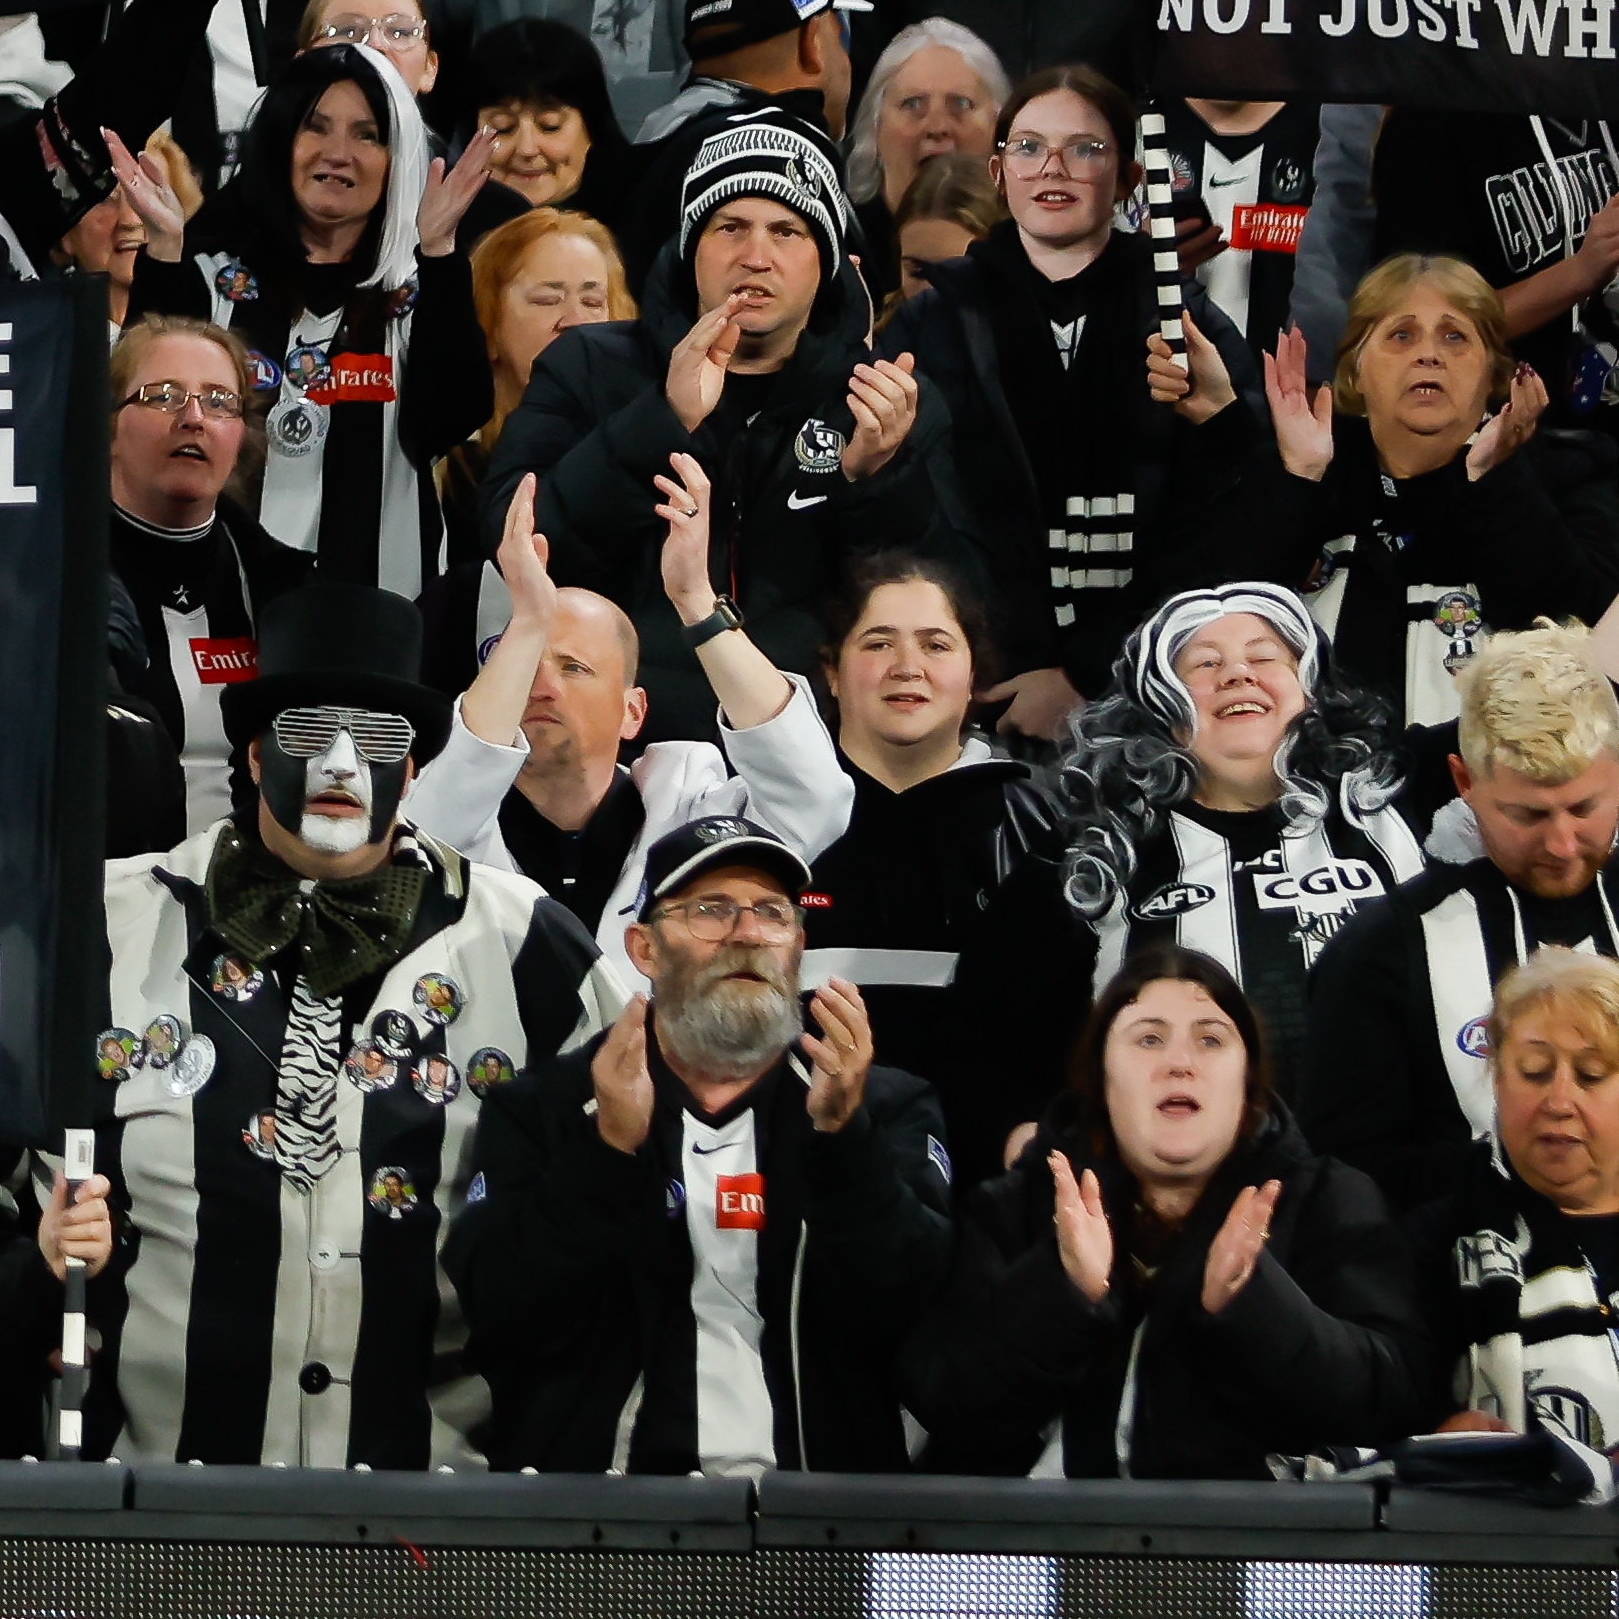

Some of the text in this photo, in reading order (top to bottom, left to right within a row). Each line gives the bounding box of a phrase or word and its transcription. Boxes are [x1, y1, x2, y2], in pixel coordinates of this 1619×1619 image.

[1240, 208, 1306, 232] Emirat
[194, 649, 258, 671] Emir
[1264, 866, 1370, 900] CGU
[799, 895, 830, 906] ates
[1140, 888, 1210, 916] AFL
